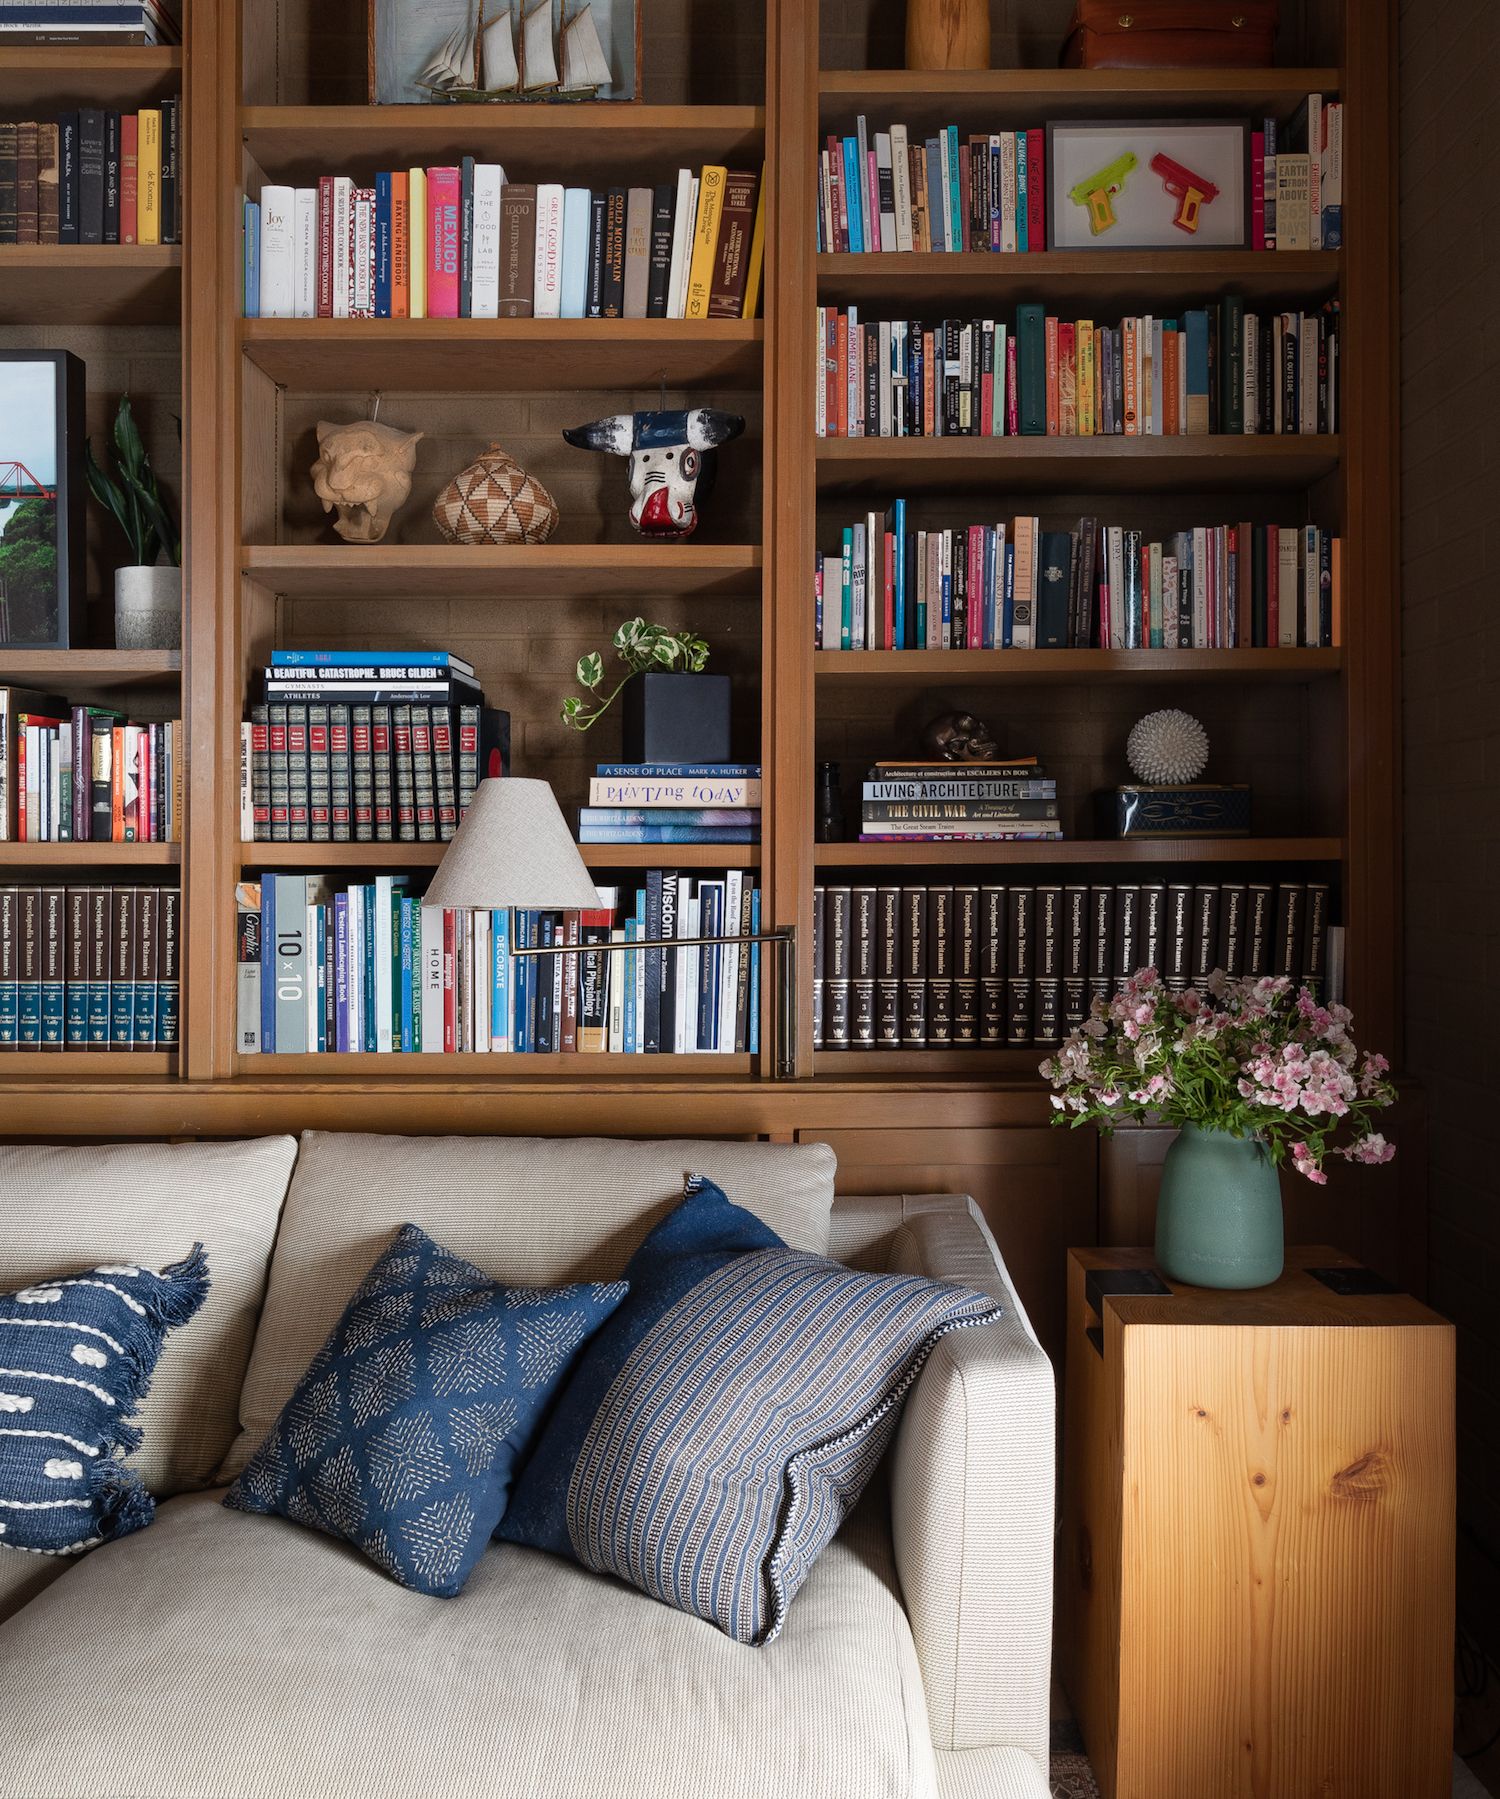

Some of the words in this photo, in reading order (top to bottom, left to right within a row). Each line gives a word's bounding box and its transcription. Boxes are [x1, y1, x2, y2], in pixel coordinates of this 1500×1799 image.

[1018, 137, 1027, 165] SALVAGE
[148, 171, 156, 179] de
[1018, 174, 1027, 195] BONES
[1279, 165, 1308, 177] EARTH
[1287, 179, 1308, 187] FROM
[147, 181, 155, 212] Kooning
[1279, 189, 1308, 201] ABOVE
[1311, 163, 1320, 215] EXHIBITIONISM
[358, 205, 367, 219] THE
[551, 197, 559, 226] GREAT
[615, 194, 624, 224] COLD
[707, 202, 715, 227] Monocle
[358, 220, 367, 233] NEW
[443, 205, 457, 273] MEXICO
[510, 214, 520, 269] GLUTEN-FREE
[704, 228, 712, 245] Guide
[728, 221, 738, 252] ECONOMIC
[337, 237, 345, 269] COOKBOOK
[358, 234, 367, 255] BASICS
[547, 228, 558, 259] GOOD
[613, 227, 623, 283] MOUNTAIN
[731, 230, 743, 278] INTERNATIONAL
[358, 256, 367, 291] COOKBOOK
[546, 262, 556, 292] FOOD
[723, 252, 734, 286] RELATIONS
[265, 668, 273, 679] A
[274, 668, 317, 679] BEAUTIFUL
[379, 668, 406, 679] BRUCE
[407, 668, 437, 679] GILDEN
[605, 768, 612, 776] A
[613, 768, 640, 776] SENSE
[641, 768, 654, 776] OF
[656, 768, 683, 776] PLACE
[872, 784, 915, 798] LIVING
[920, 784, 1019, 797] ARCHITECTURE
[886, 805, 909, 818] THE
[912, 805, 941, 818] CIVIL
[944, 805, 967, 818] WAR
[730, 878, 738, 886] Up
[662, 875, 677, 938] Wisdom
[742, 889, 752, 928] ORIGINAL
[243, 914, 260, 956] Graphic
[338, 910, 346, 939] Western
[48, 941, 56, 976] Britannica
[95, 941, 103, 976] Britannica
[165, 941, 174, 976] Britannica
[278, 930, 302, 957] 10
[586, 935, 596, 968] Mical
[739, 929, 750, 969] PRSCHE
[860, 939, 868, 975] Britannica
[1018, 939, 1026, 975] Britannica
[1175, 937, 1184, 973] Britannica
[337, 940, 347, 983] Landscaping
[412, 948, 420, 988] ORNAMENTAL
[431, 949, 440, 990] HOME
[443, 953, 453, 990] photography
[496, 935, 505, 989] DECORATE
[739, 970, 747, 982] 911
[277, 974, 303, 1001] 10
[412, 990, 420, 1014] GRASSES
[583, 970, 596, 1017] Physiology
[636, 984, 644, 1000] Easy
